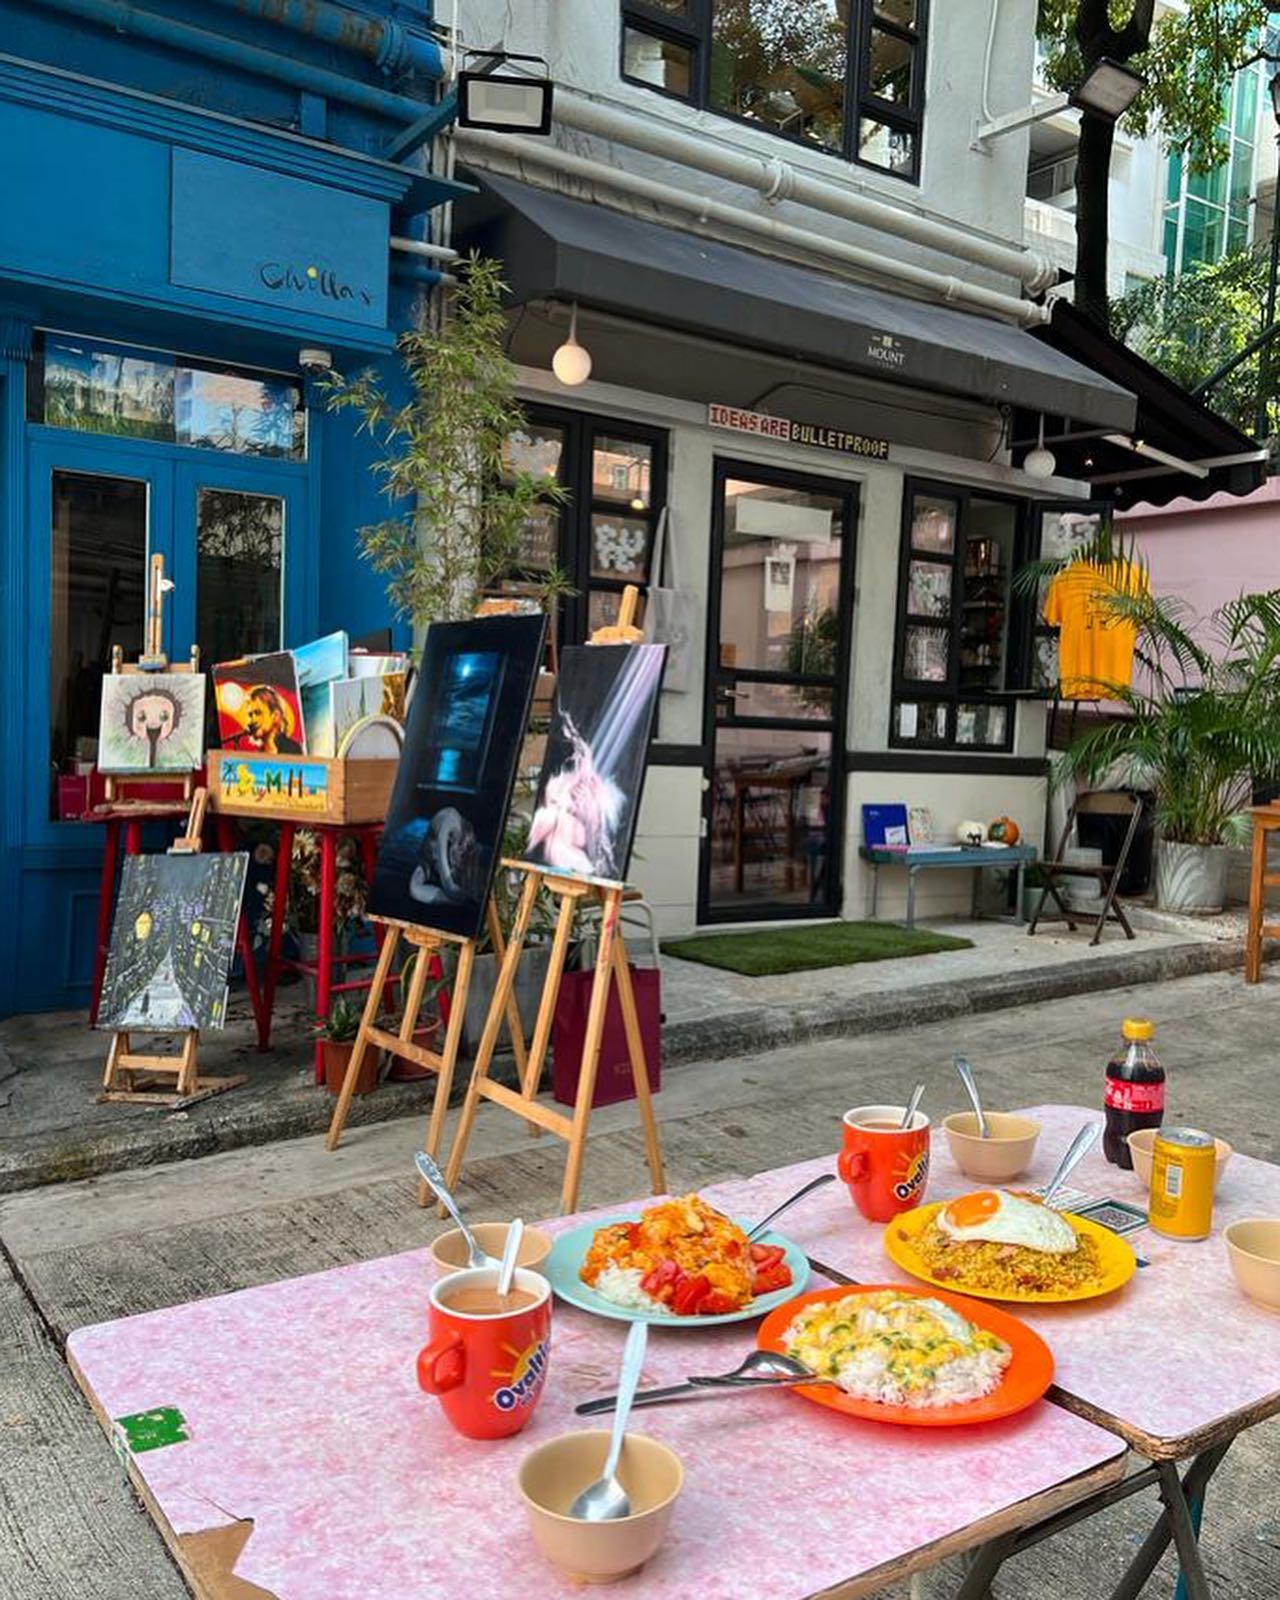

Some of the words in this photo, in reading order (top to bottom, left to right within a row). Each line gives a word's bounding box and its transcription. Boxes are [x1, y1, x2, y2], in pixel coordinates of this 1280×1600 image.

[867, 345, 905, 365] MOUNT
[711, 406, 759, 430] IDEAS
[760, 417, 789, 438] ARE
[791, 423, 888, 456] BULLETPROOF
